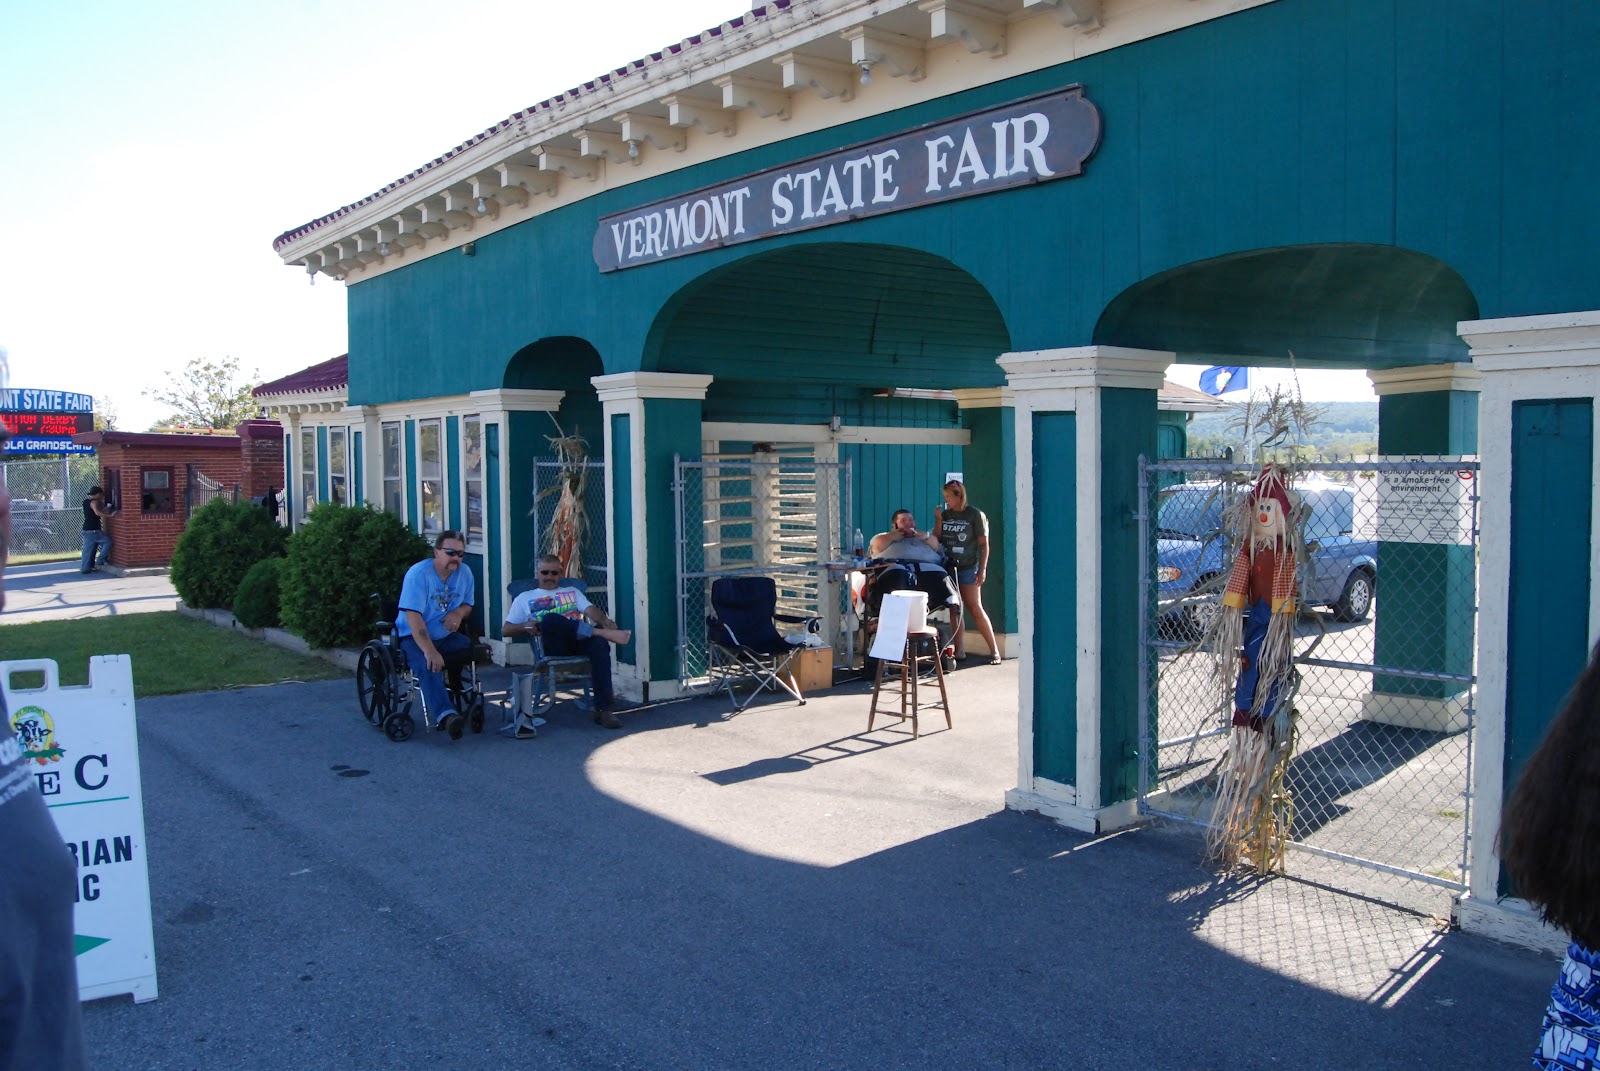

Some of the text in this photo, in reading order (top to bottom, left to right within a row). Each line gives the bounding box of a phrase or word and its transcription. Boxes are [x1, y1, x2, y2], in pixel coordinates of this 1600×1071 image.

[611, 112, 1055, 264] VERMONT STATE FAIR
[24, 389, 62, 410] STATE
[65, 392, 91, 410] FAIR
[42, 415, 77, 425] DERBY
[1402, 476, 1450, 484] smoke-free
[943, 524, 967, 532] STAFF
[75, 754, 109, 790] C
